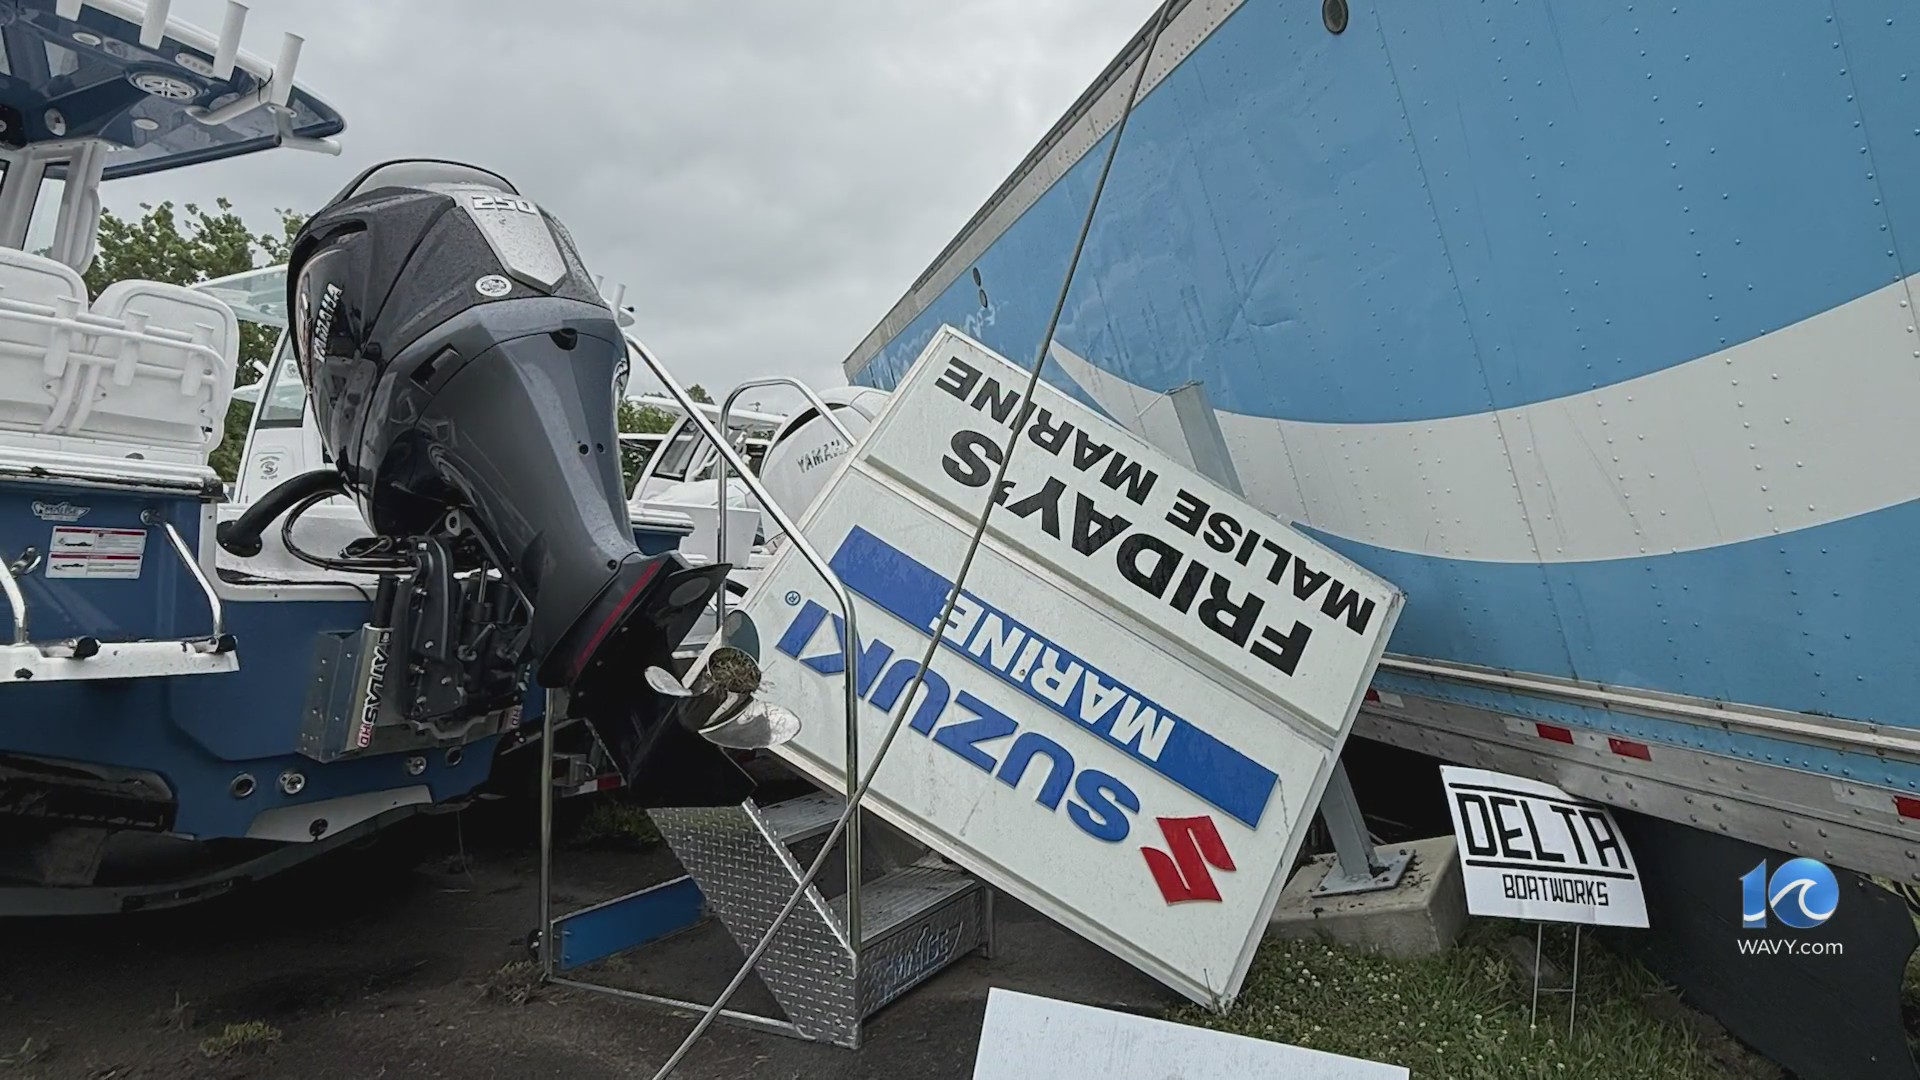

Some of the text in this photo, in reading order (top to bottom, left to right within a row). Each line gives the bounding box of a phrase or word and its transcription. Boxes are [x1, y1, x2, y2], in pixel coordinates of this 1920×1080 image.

[472, 195, 537, 215] 250
[313, 283, 342, 363] YAMAHA
[934, 355, 1377, 636] MALISE MARINE
[941, 428, 1313, 678] FRIDAY'S
[362, 644, 390, 726] ATLAS
[928, 588, 1176, 763] MARINE
[775, 599, 1141, 844] SUZUKI
[1456, 792, 1629, 869] DELTA
[1502, 873, 1611, 907] BOATWORKS
